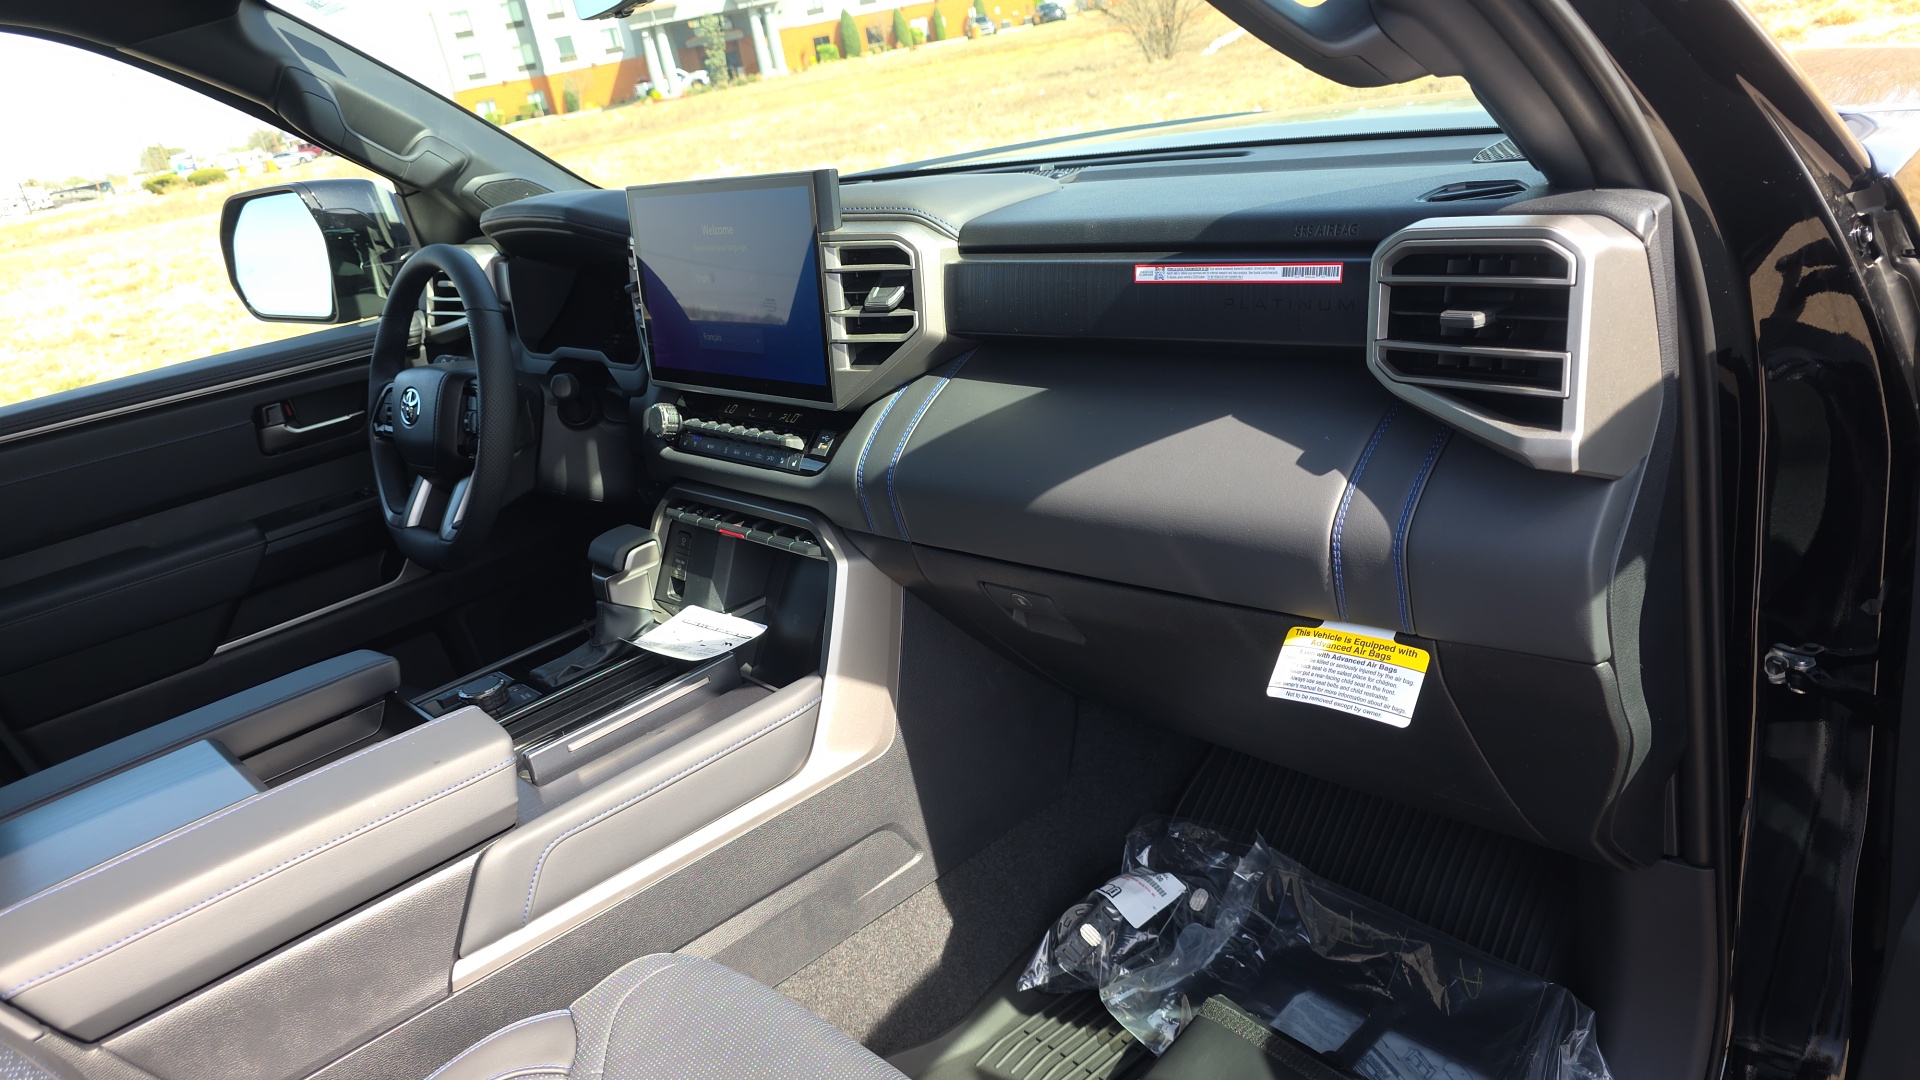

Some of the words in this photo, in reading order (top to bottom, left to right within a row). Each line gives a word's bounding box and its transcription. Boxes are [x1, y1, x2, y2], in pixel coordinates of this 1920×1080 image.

[702, 224, 734, 235] Welcome
[1294, 225, 1313, 236] SRS
[1314, 224, 1358, 236] AIRBAG
[1224, 298, 1355, 311] PLATINUM
[1311, 640, 1352, 652] Advanced
[1353, 647, 1366, 655] Air
[1368, 650, 1392, 661] Bags
[1314, 630, 1342, 642] Vehicle
[1354, 638, 1396, 652] Equipped
[1399, 648, 1418, 658] with
[1331, 654, 1366, 666] Advanced
[1379, 664, 1398, 674] Bags
[1315, 672, 1340, 683] rear-facing
[1382, 686, 1395, 695] front.
[1336, 663, 1358, 672] seriously
[1359, 667, 1376, 676] injured
[1403, 677, 1414, 686] bag.
[1352, 673, 1366, 681] place
[1376, 678, 1397, 688] children.
[1338, 691, 1366, 703] information
[1367, 700, 1382, 708] about
[1392, 705, 1406, 714] bags.
[1363, 690, 1389, 701] restraints.
[1308, 696, 1333, 705] removed
[1334, 703, 1353, 711] except
[1362, 710, 1382, 718] owner.
